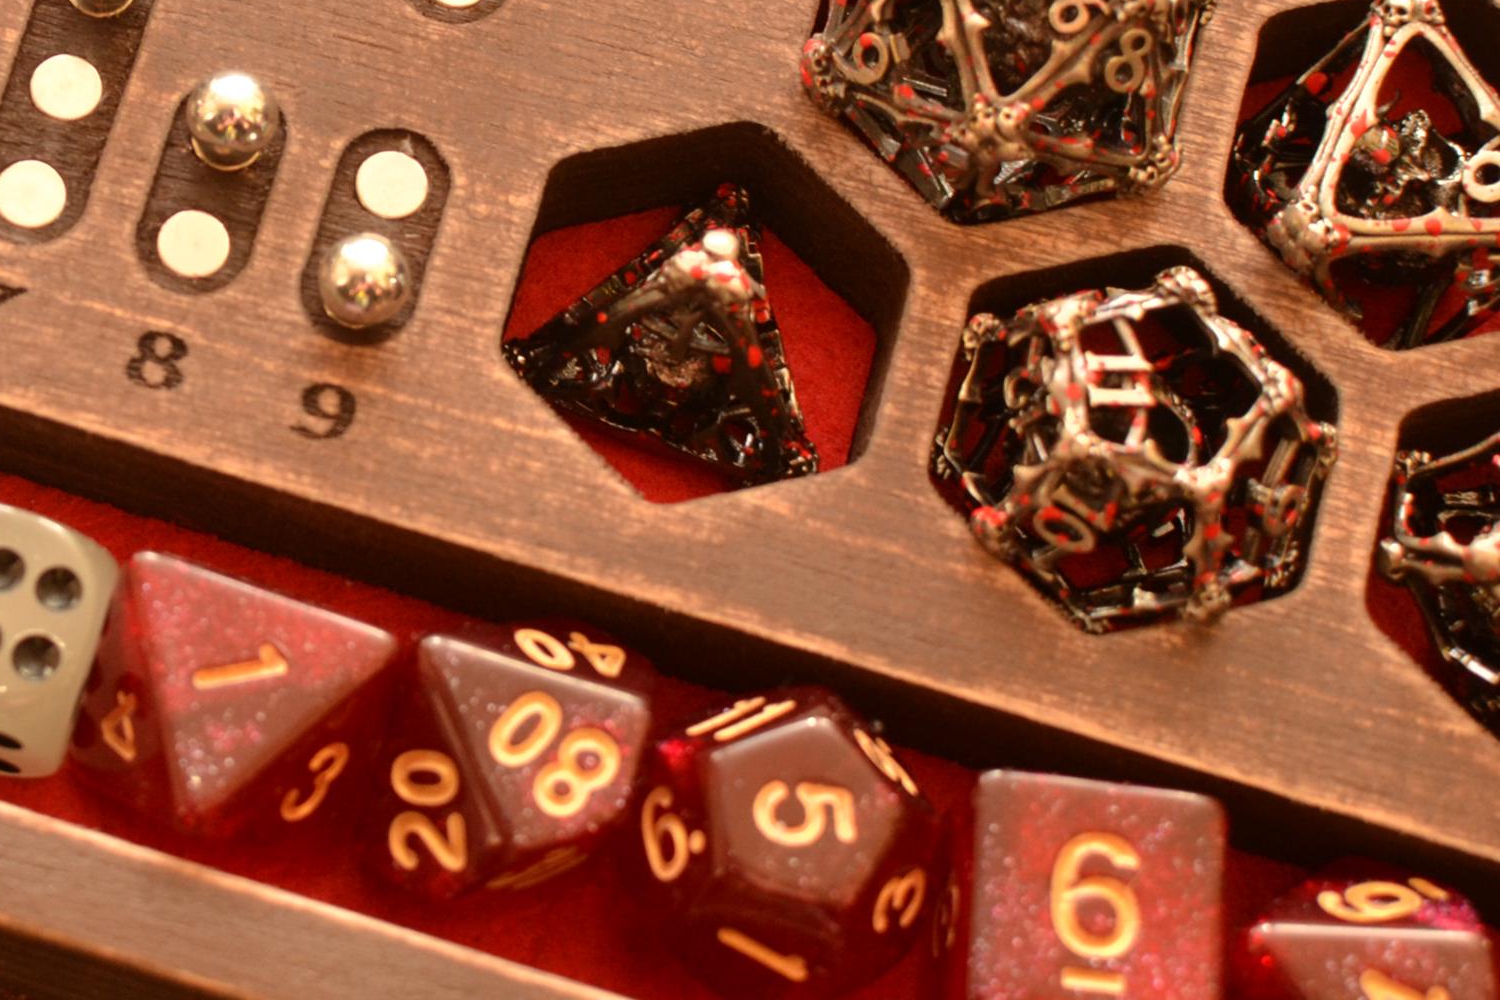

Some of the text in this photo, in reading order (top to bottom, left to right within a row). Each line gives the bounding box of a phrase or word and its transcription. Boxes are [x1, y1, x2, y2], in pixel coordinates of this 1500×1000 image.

[126, 330, 191, 391] 8
[291, 382, 359, 441] 9
[192, 642, 289, 691] 1
[280, 742, 350, 822] 3
[488, 690, 622, 819] 80
[388, 749, 468, 872] 20
[752, 779, 859, 848] 5
[872, 867, 927, 934] 3
[717, 926, 809, 982] 1
